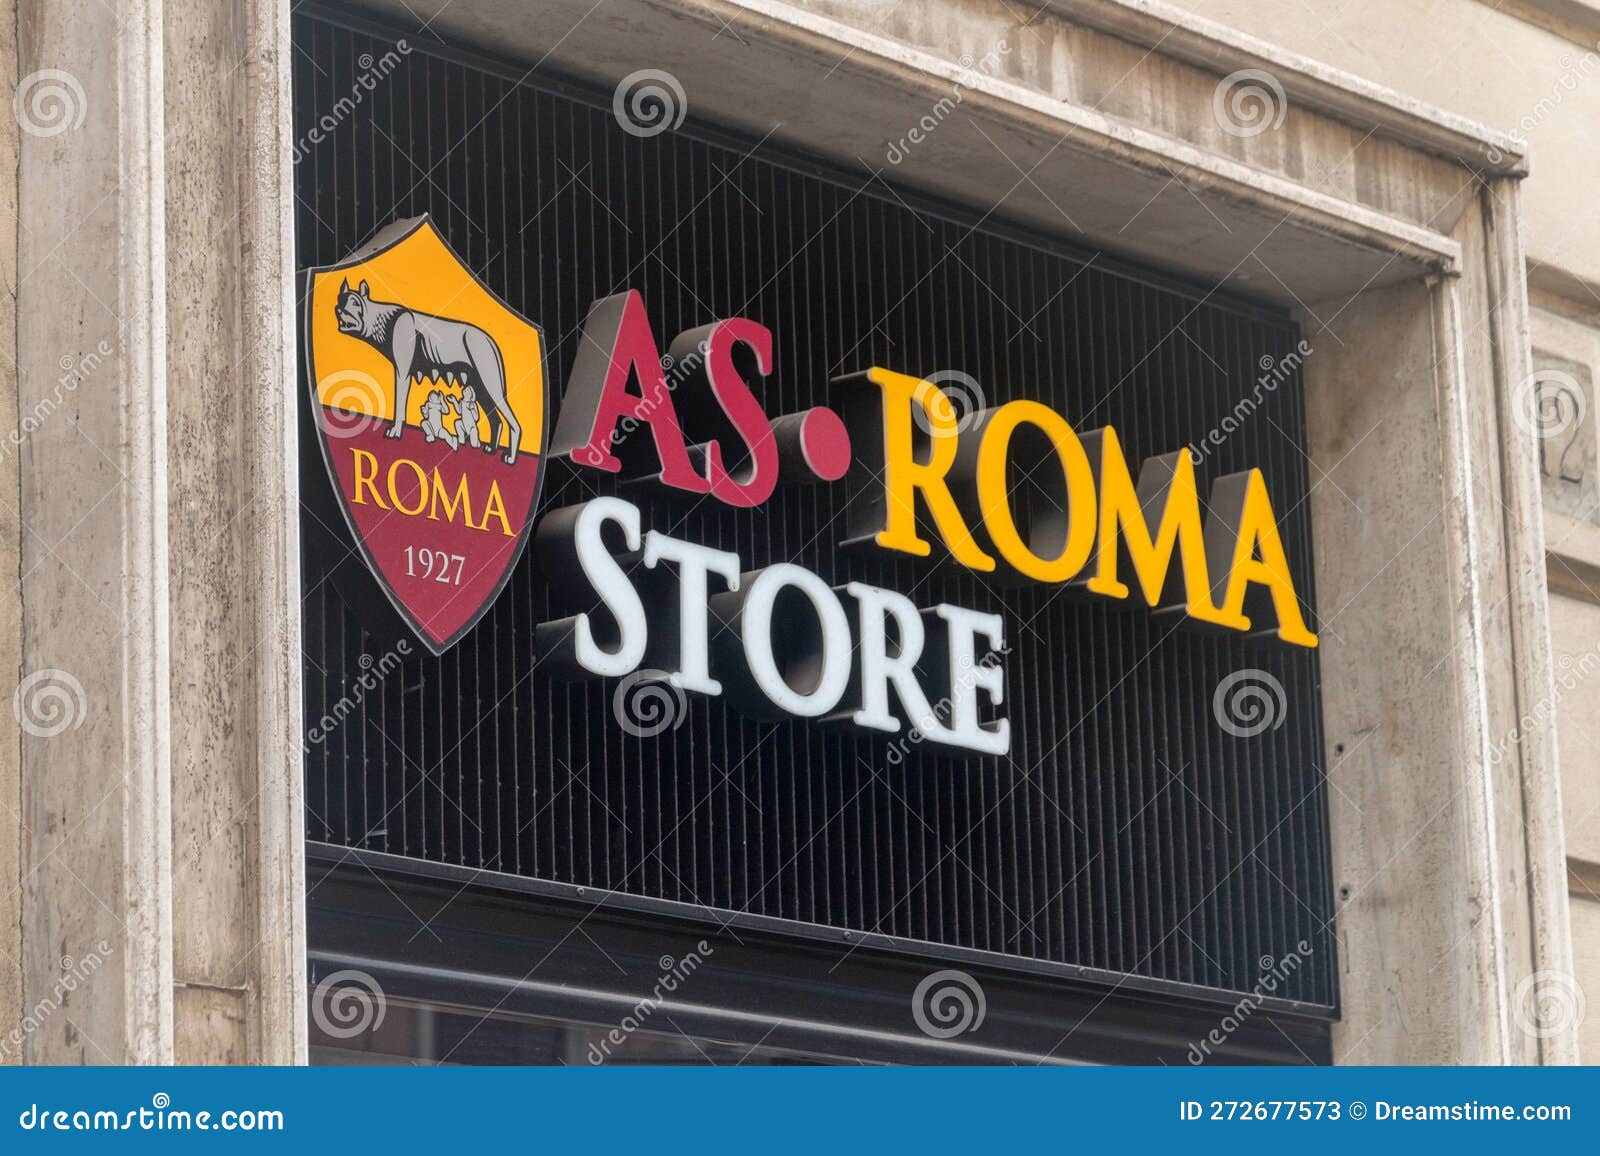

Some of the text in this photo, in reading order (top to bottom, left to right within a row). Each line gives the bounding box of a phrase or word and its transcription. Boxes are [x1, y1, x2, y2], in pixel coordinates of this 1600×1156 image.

[349, 447, 517, 537] ROMA
[403, 545, 466, 586] 1927
[869, 366, 1320, 648] ROMA
[574, 496, 1010, 756] STORE
